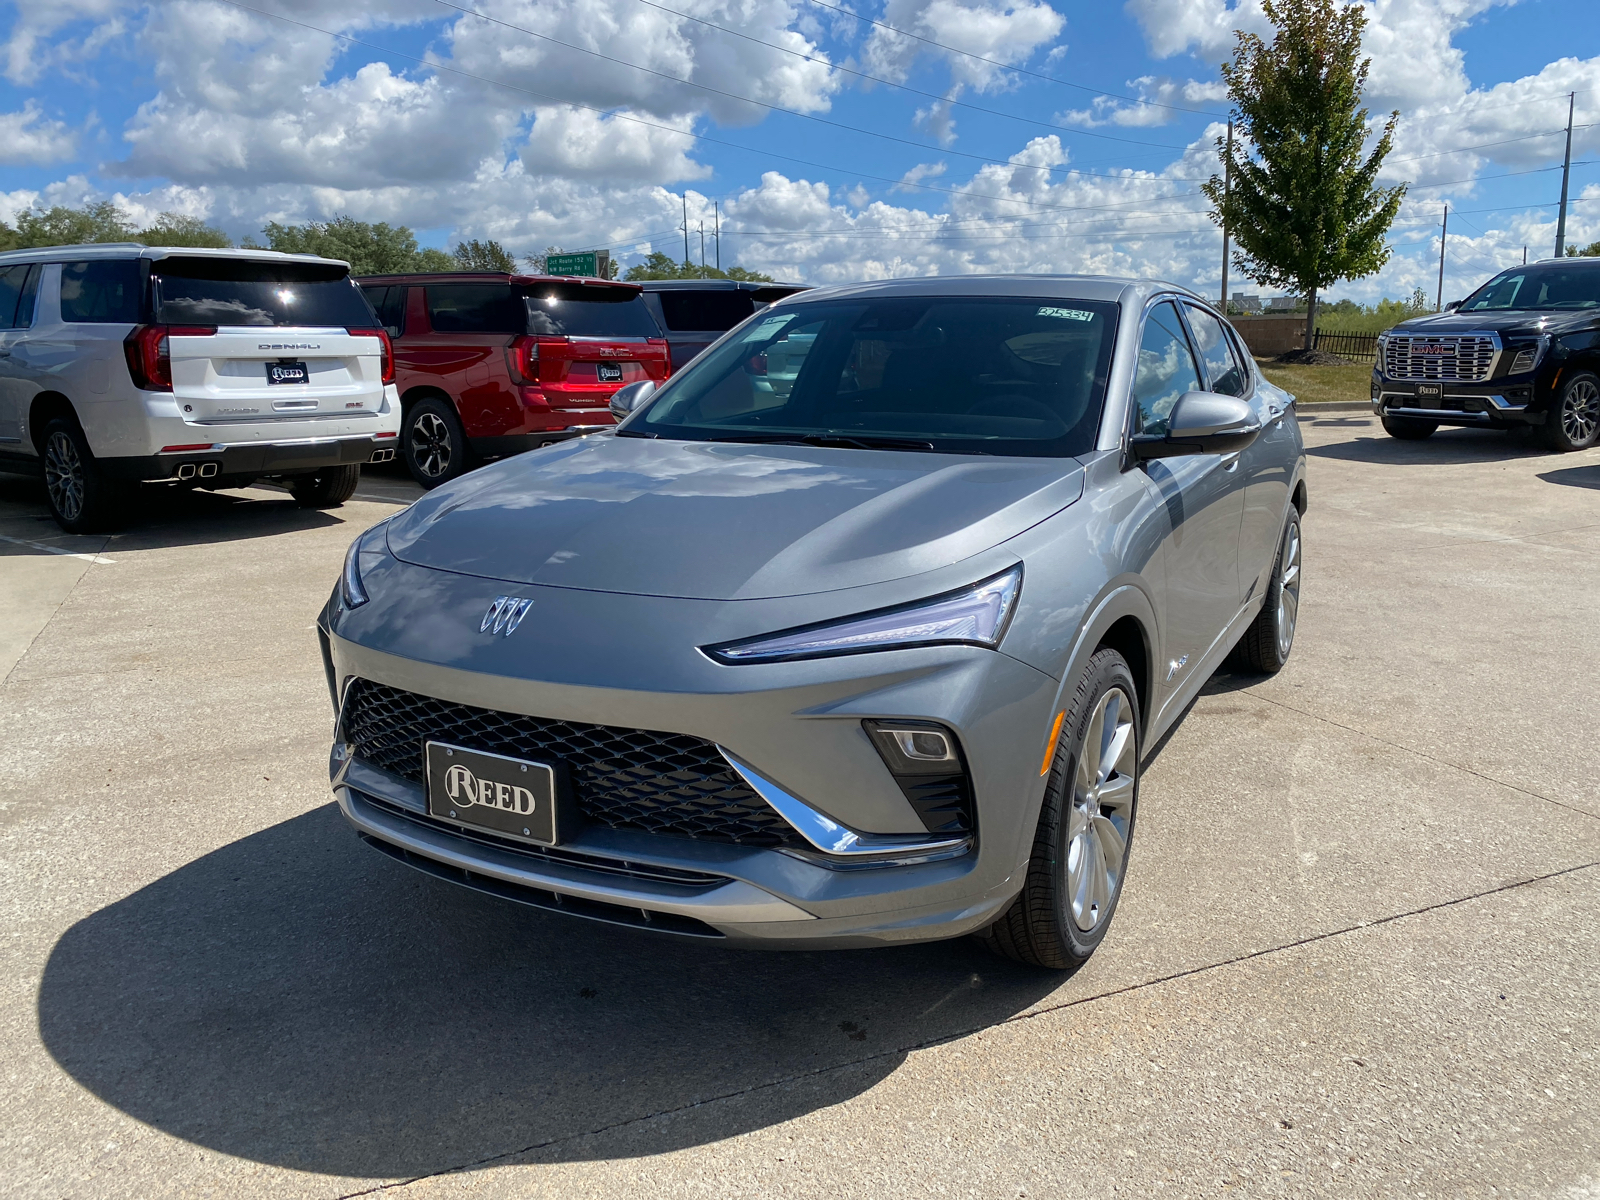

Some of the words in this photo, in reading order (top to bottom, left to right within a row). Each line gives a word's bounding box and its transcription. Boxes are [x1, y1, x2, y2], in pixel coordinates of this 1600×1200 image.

[600, 347, 630, 356] GMC
[1411, 344, 1454, 354] GMC
[271, 366, 304, 380] REED
[1418, 386, 1439, 395] REED
[1077, 683, 1099, 741] Continental
[445, 764, 536, 815] REED
